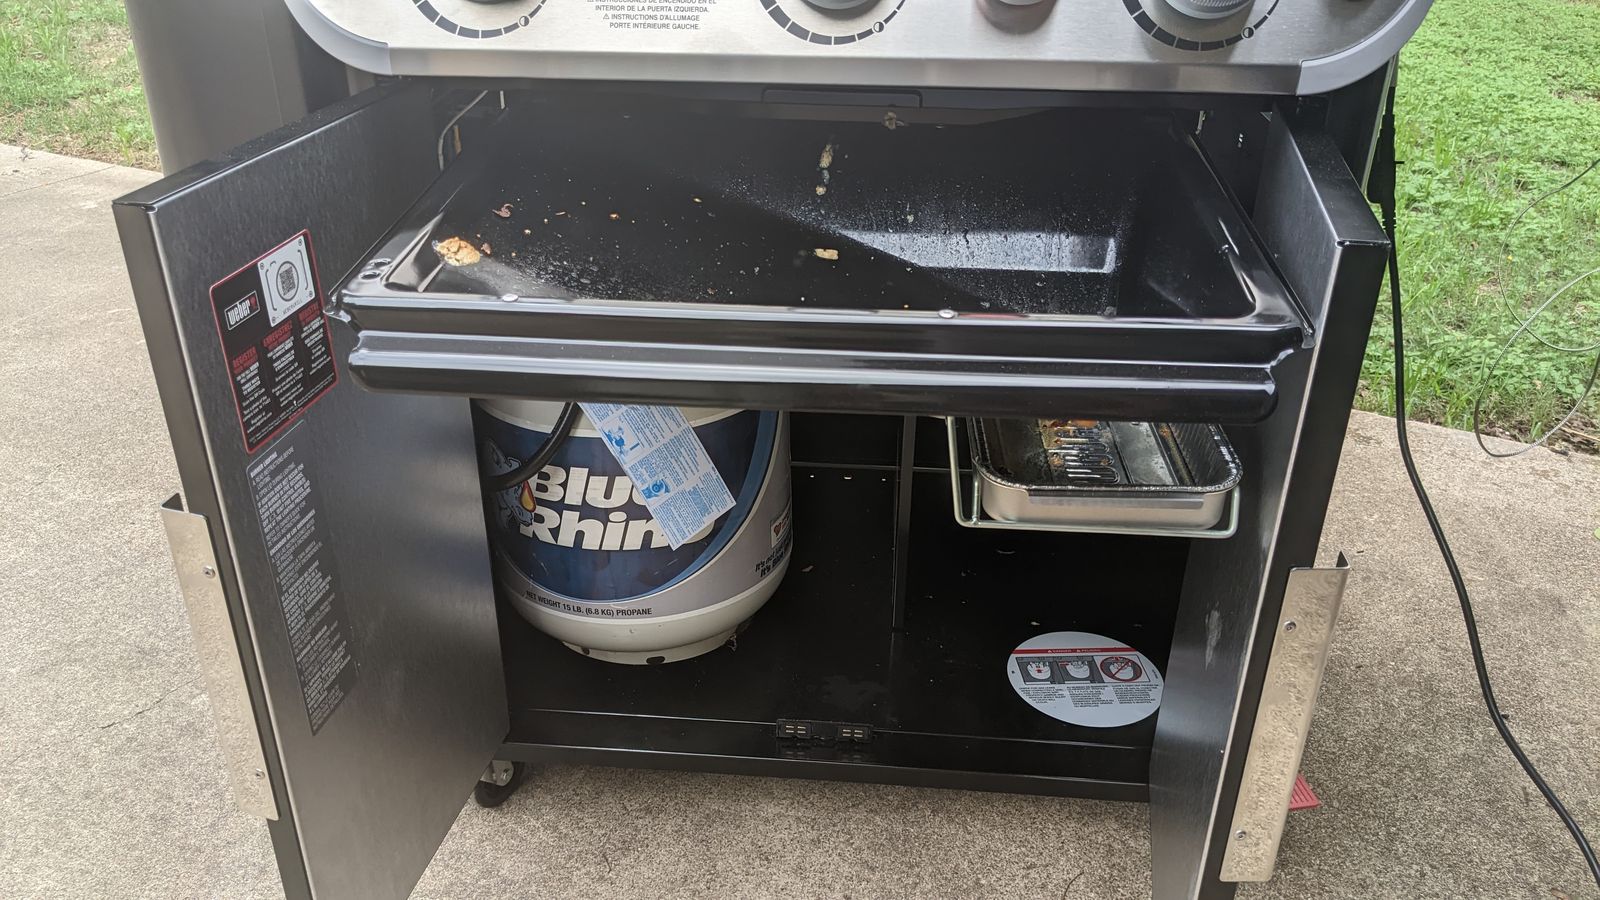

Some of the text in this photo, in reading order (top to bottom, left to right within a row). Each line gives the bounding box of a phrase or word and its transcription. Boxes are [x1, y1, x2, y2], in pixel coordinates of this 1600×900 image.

[611, 13, 658, 21] INSTRUCTIONS
[227, 298, 251, 325] weber
[520, 506, 714, 551] Rhin
[526, 590, 652, 617] NET WEIGHT 15 LB. (6.8 KG) PROPANE
